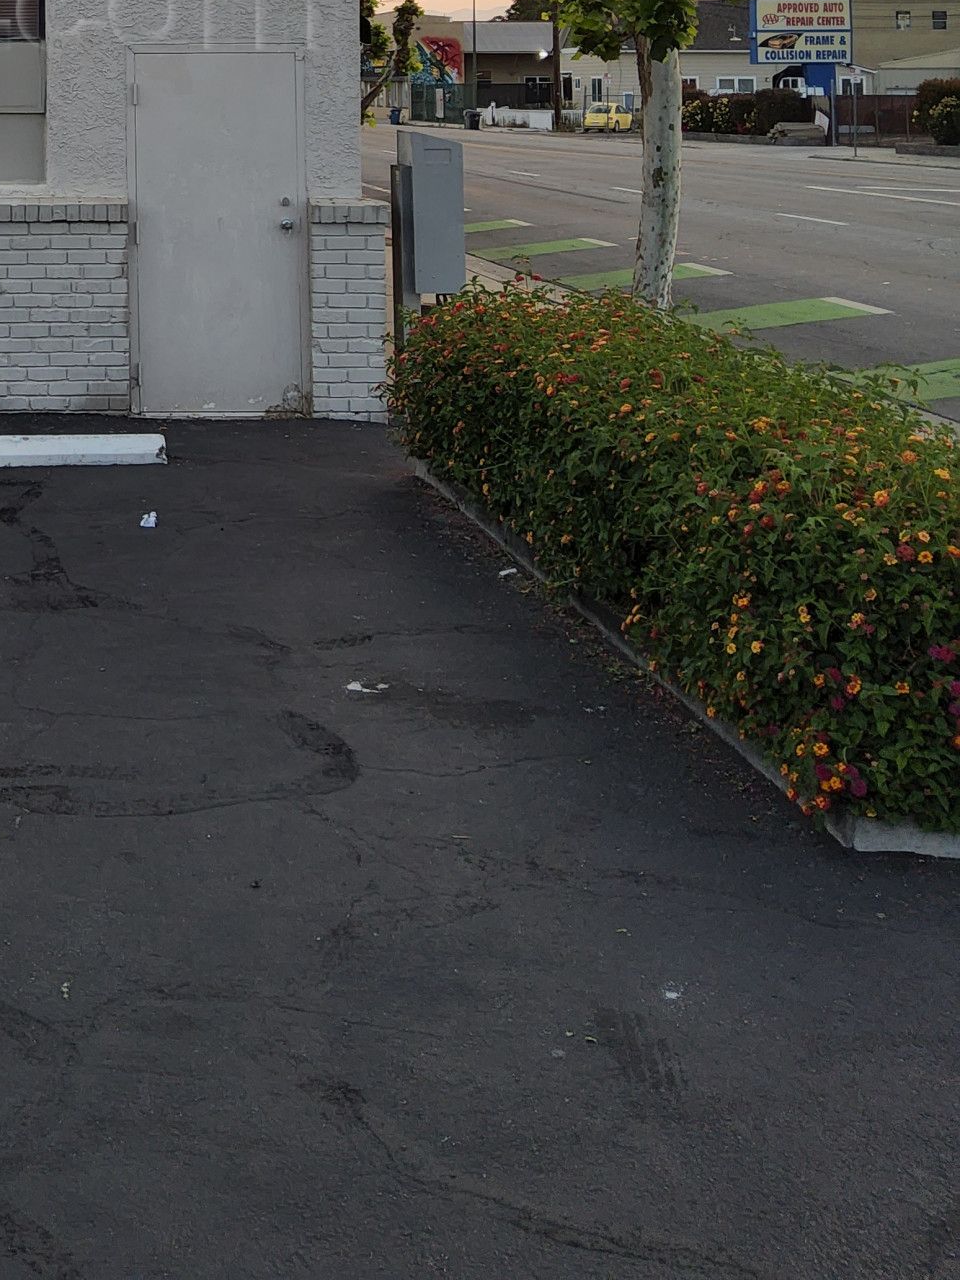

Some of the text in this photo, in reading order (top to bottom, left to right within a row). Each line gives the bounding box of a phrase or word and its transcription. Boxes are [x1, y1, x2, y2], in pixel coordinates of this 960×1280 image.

[777, 2, 844, 13] APPROVED AUTO
[786, 16, 845, 26] REPAIR CENTER
[805, 35, 846, 45] FRAME &
[765, 50, 847, 60] COLLISION REPAIR
